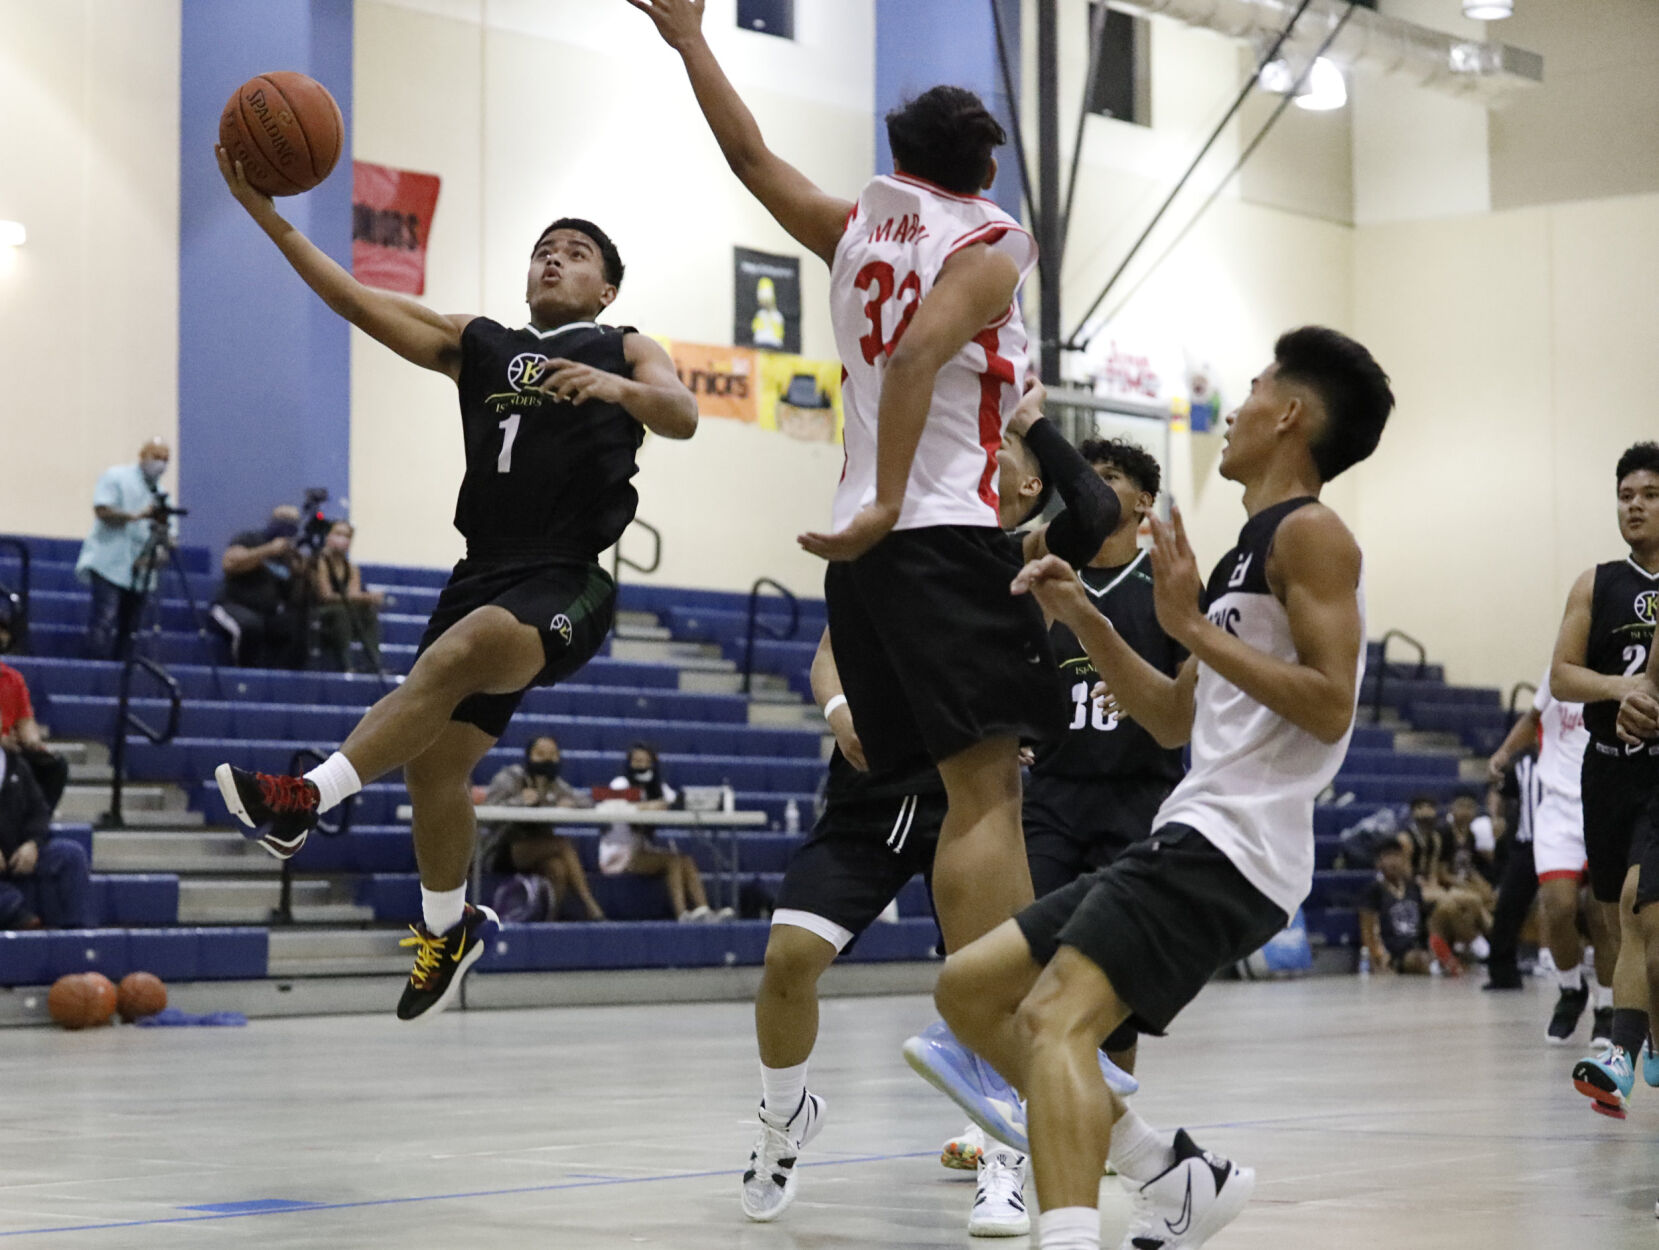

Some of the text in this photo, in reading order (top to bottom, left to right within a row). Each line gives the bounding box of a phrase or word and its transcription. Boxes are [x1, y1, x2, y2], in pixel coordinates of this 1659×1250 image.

[246, 89, 294, 167] SPALDING
[854, 260, 921, 367] 32
[498, 414, 521, 473] 1
